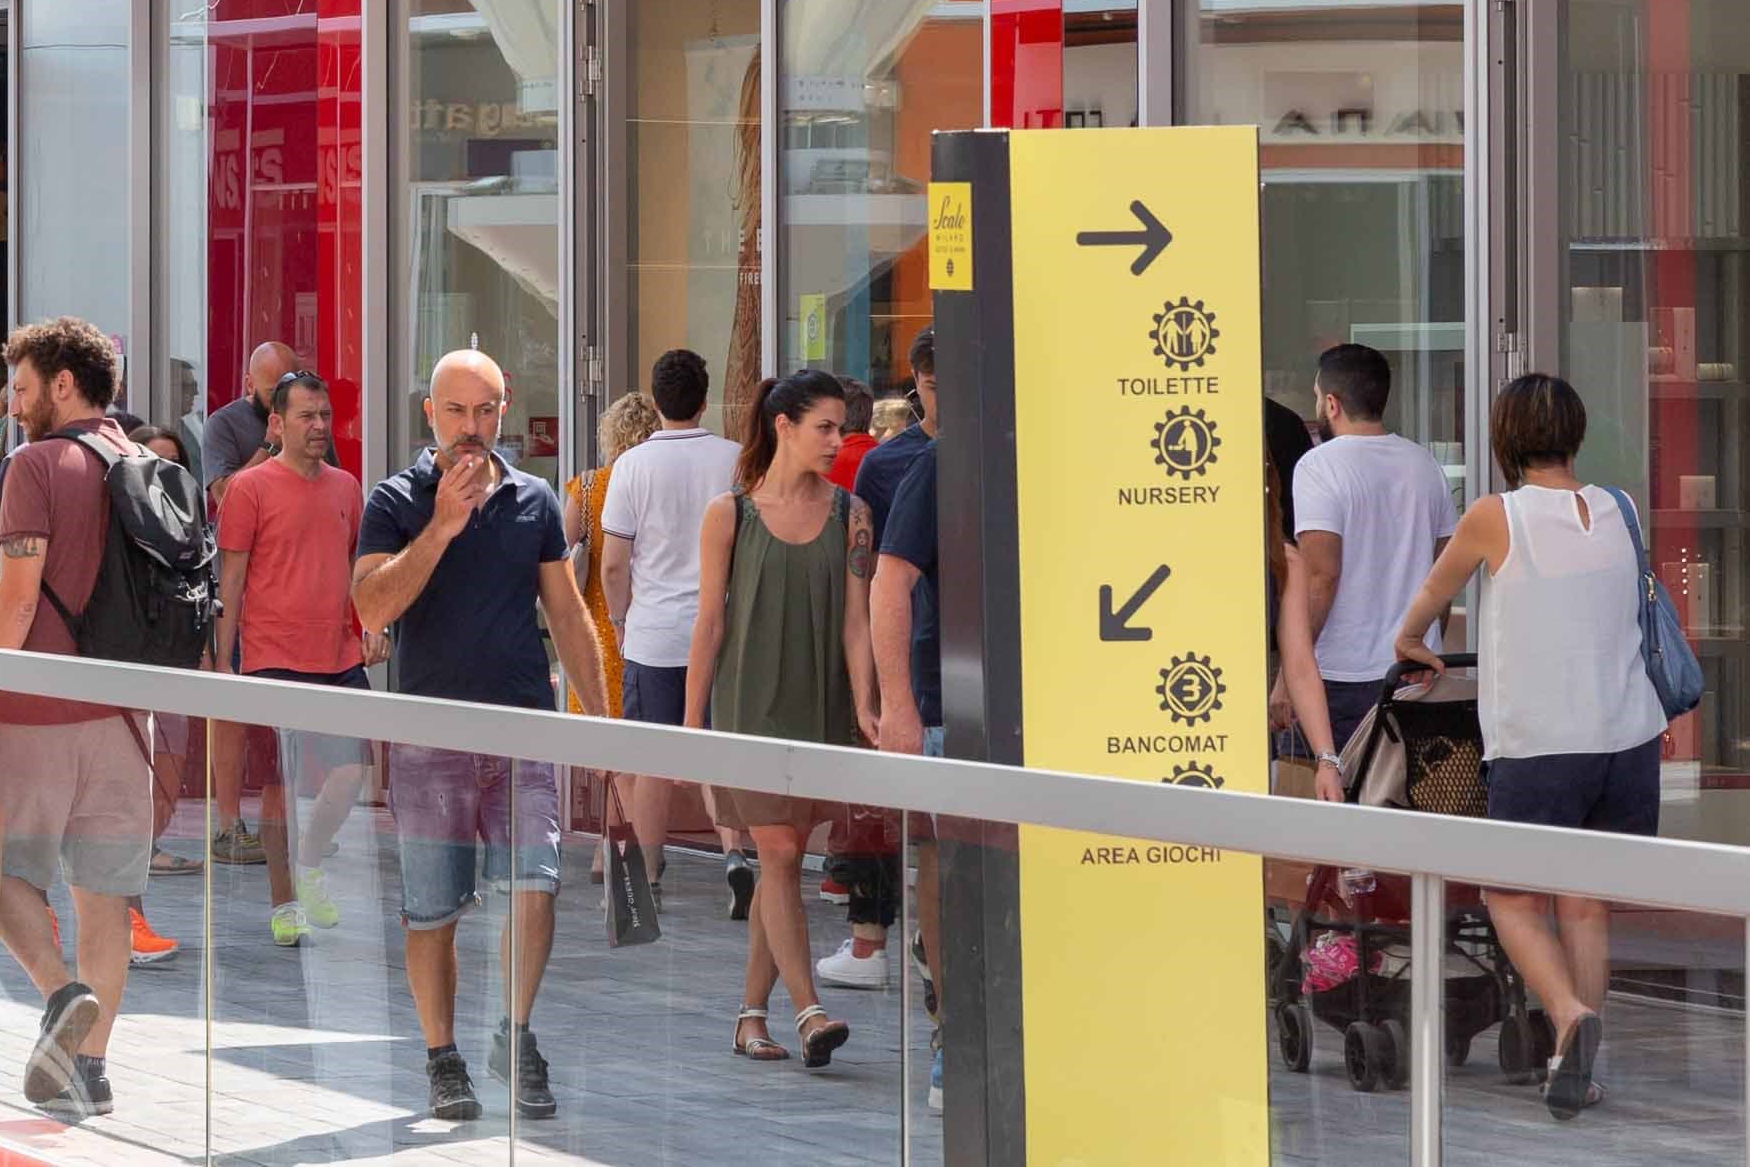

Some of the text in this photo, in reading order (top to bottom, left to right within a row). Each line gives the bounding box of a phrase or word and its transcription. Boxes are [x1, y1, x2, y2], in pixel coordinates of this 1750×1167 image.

[1117, 376, 1219, 396] TOILETTE
[1117, 485, 1221, 506] NURSERY
[1106, 734, 1229, 754] BANCOMAT
[1080, 846, 1221, 865] AREA GIOCHI
